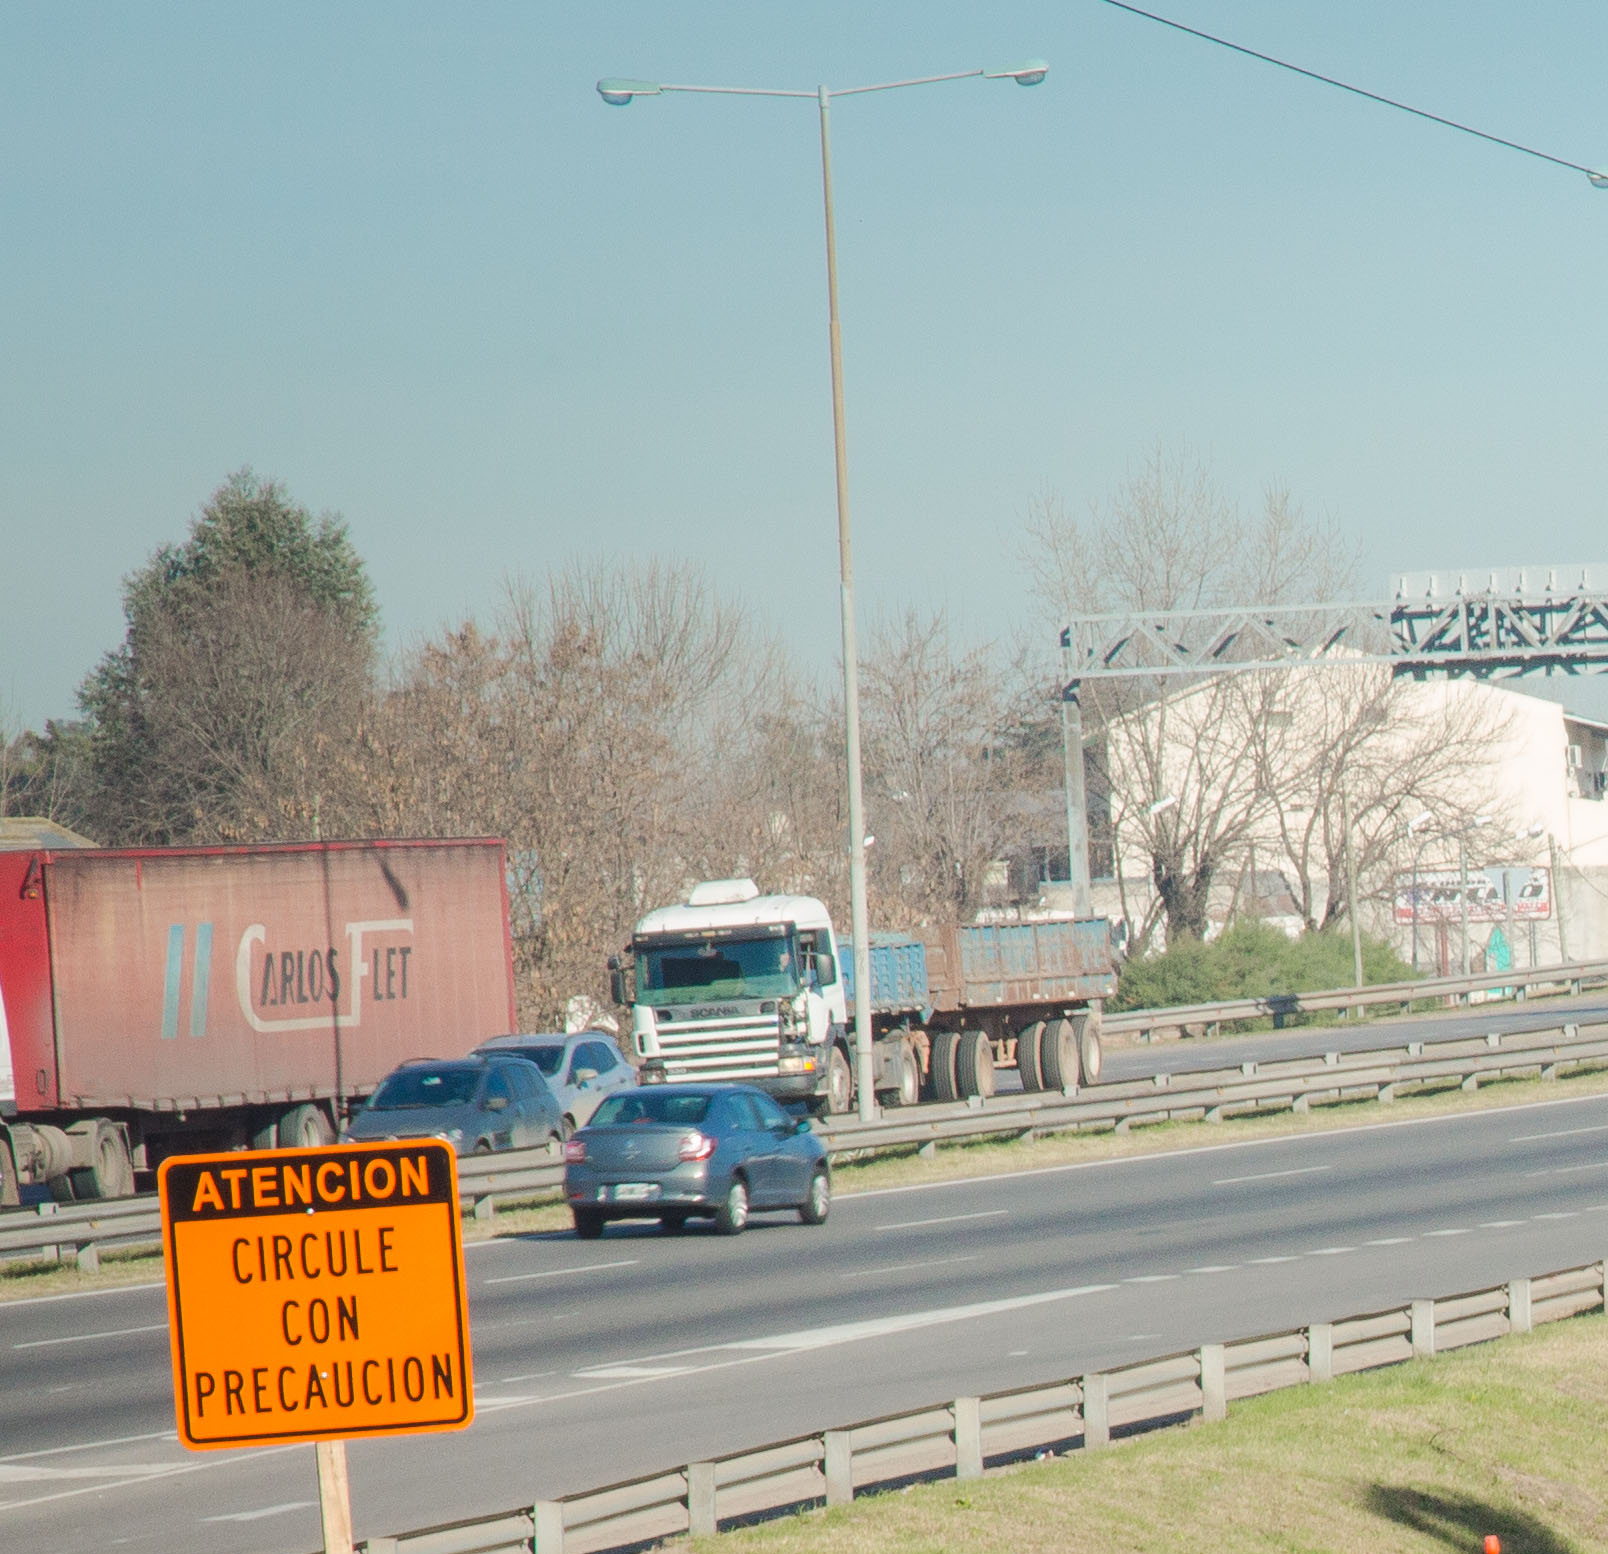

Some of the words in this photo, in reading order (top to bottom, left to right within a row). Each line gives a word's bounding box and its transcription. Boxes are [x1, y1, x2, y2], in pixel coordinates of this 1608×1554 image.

[236, 923, 346, 1033] CARLOS
[345, 919, 414, 1026] FLET
[192, 1155, 430, 1213] ATENCION
[232, 1227, 398, 1284] CIRCULE
[282, 1295, 360, 1346] CON
[195, 1353, 454, 1418] PRECAUCION
